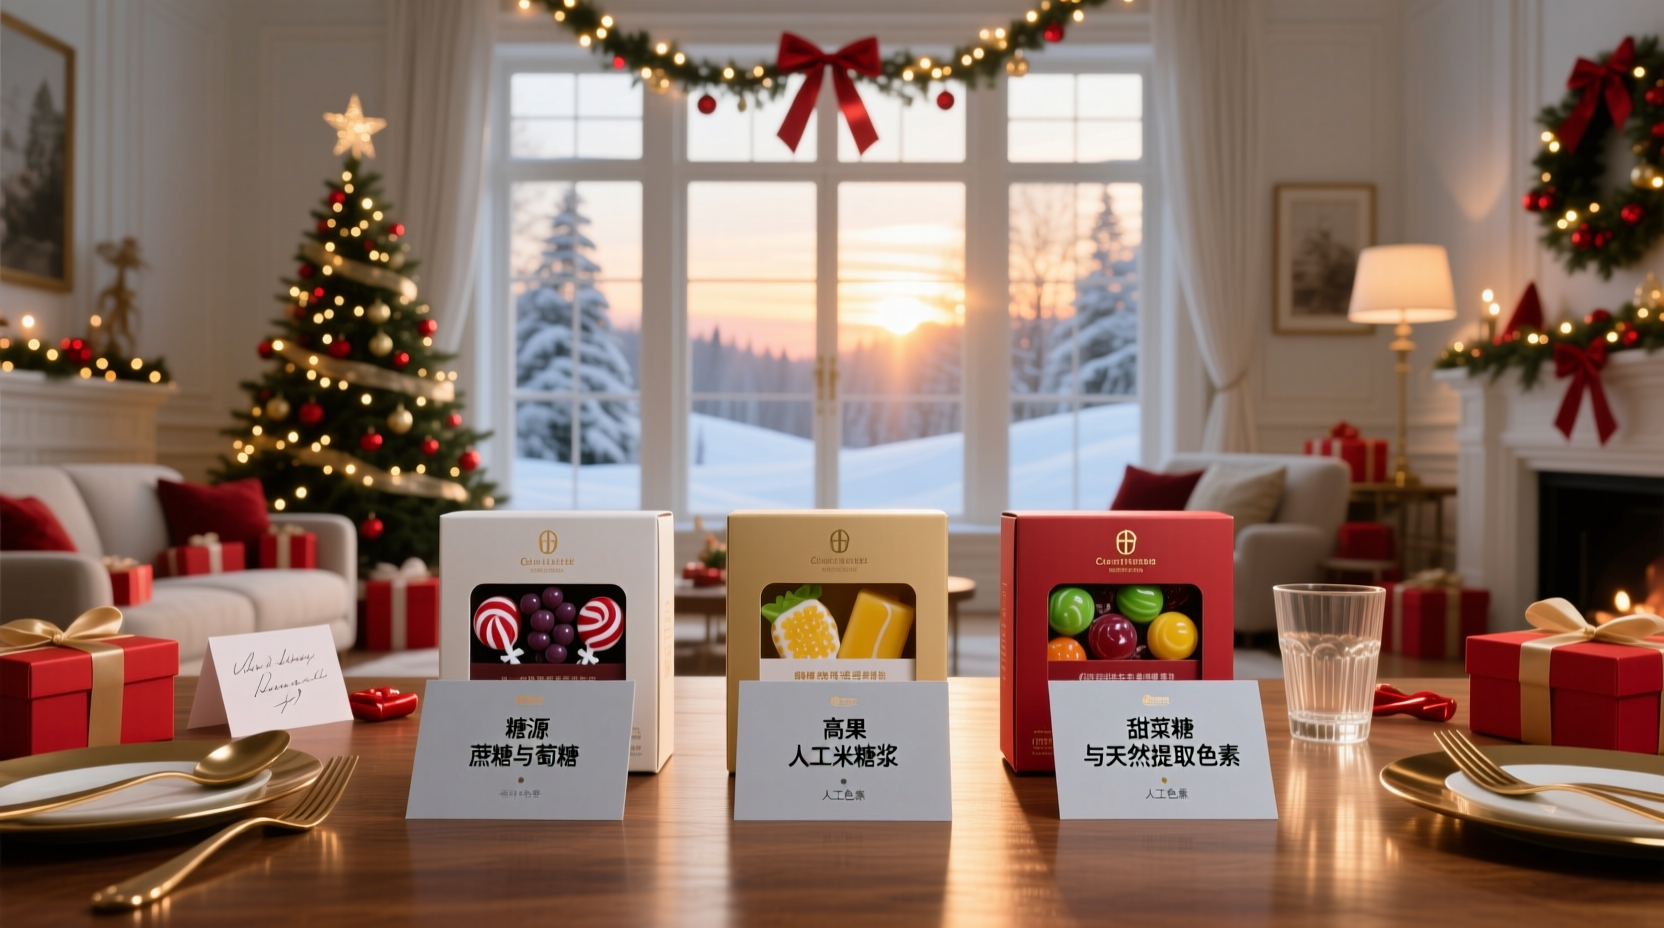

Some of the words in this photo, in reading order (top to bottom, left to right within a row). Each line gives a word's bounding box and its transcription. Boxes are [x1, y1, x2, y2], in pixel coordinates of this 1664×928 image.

[505, 716, 551, 740] 糖源
[822, 716, 867, 741] 高果
[1126, 716, 1194, 740] 甜菜糖
[788, 743, 899, 768] 人工米糖浆
[1083, 743, 1240, 768] 与天然提取色素
